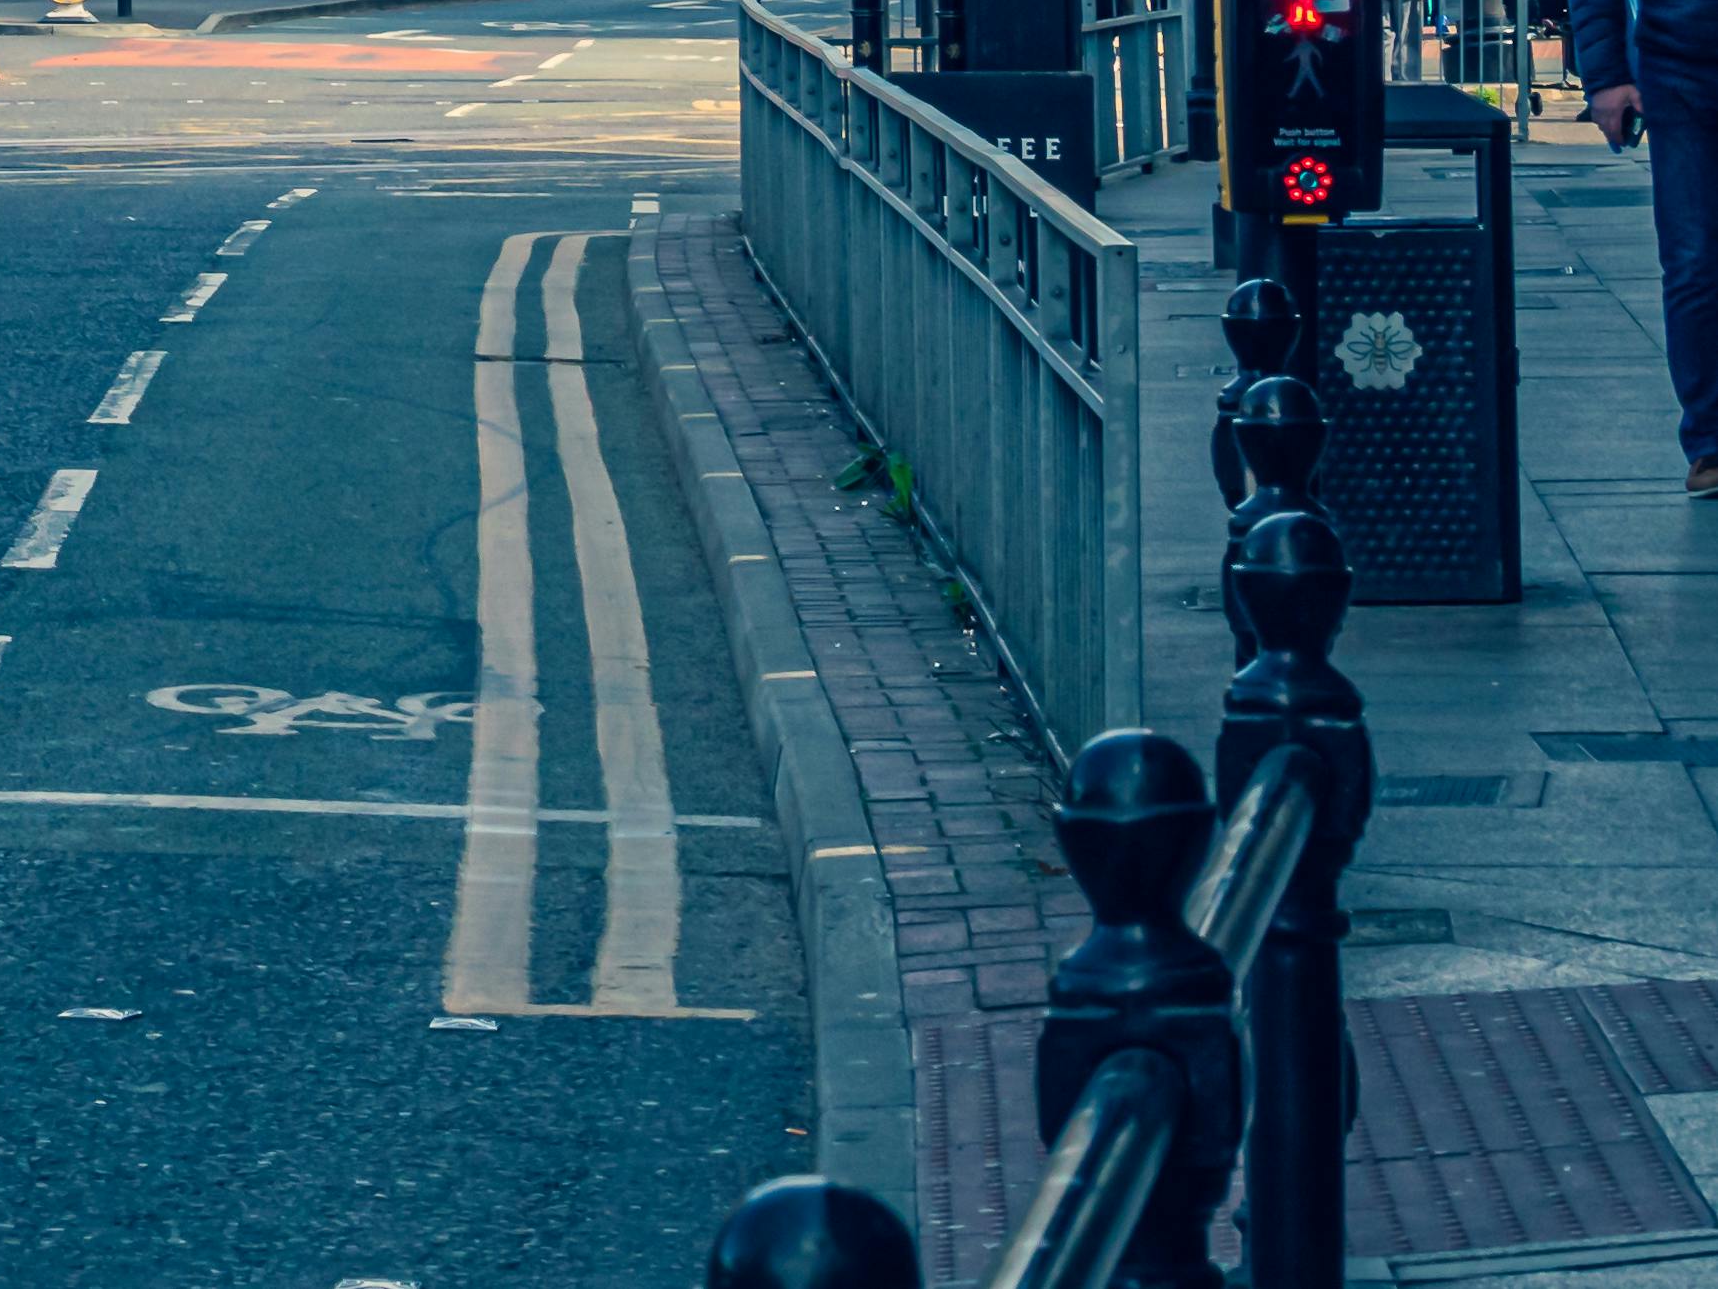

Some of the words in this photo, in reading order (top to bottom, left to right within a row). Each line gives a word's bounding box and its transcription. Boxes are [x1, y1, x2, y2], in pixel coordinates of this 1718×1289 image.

[1279, 127, 1302, 136] Push
[1304, 127, 1335, 136] button
[1273, 137, 1295, 146] Wait
[1297, 137, 1311, 146] for
[1313, 137, 1341, 147] signal
